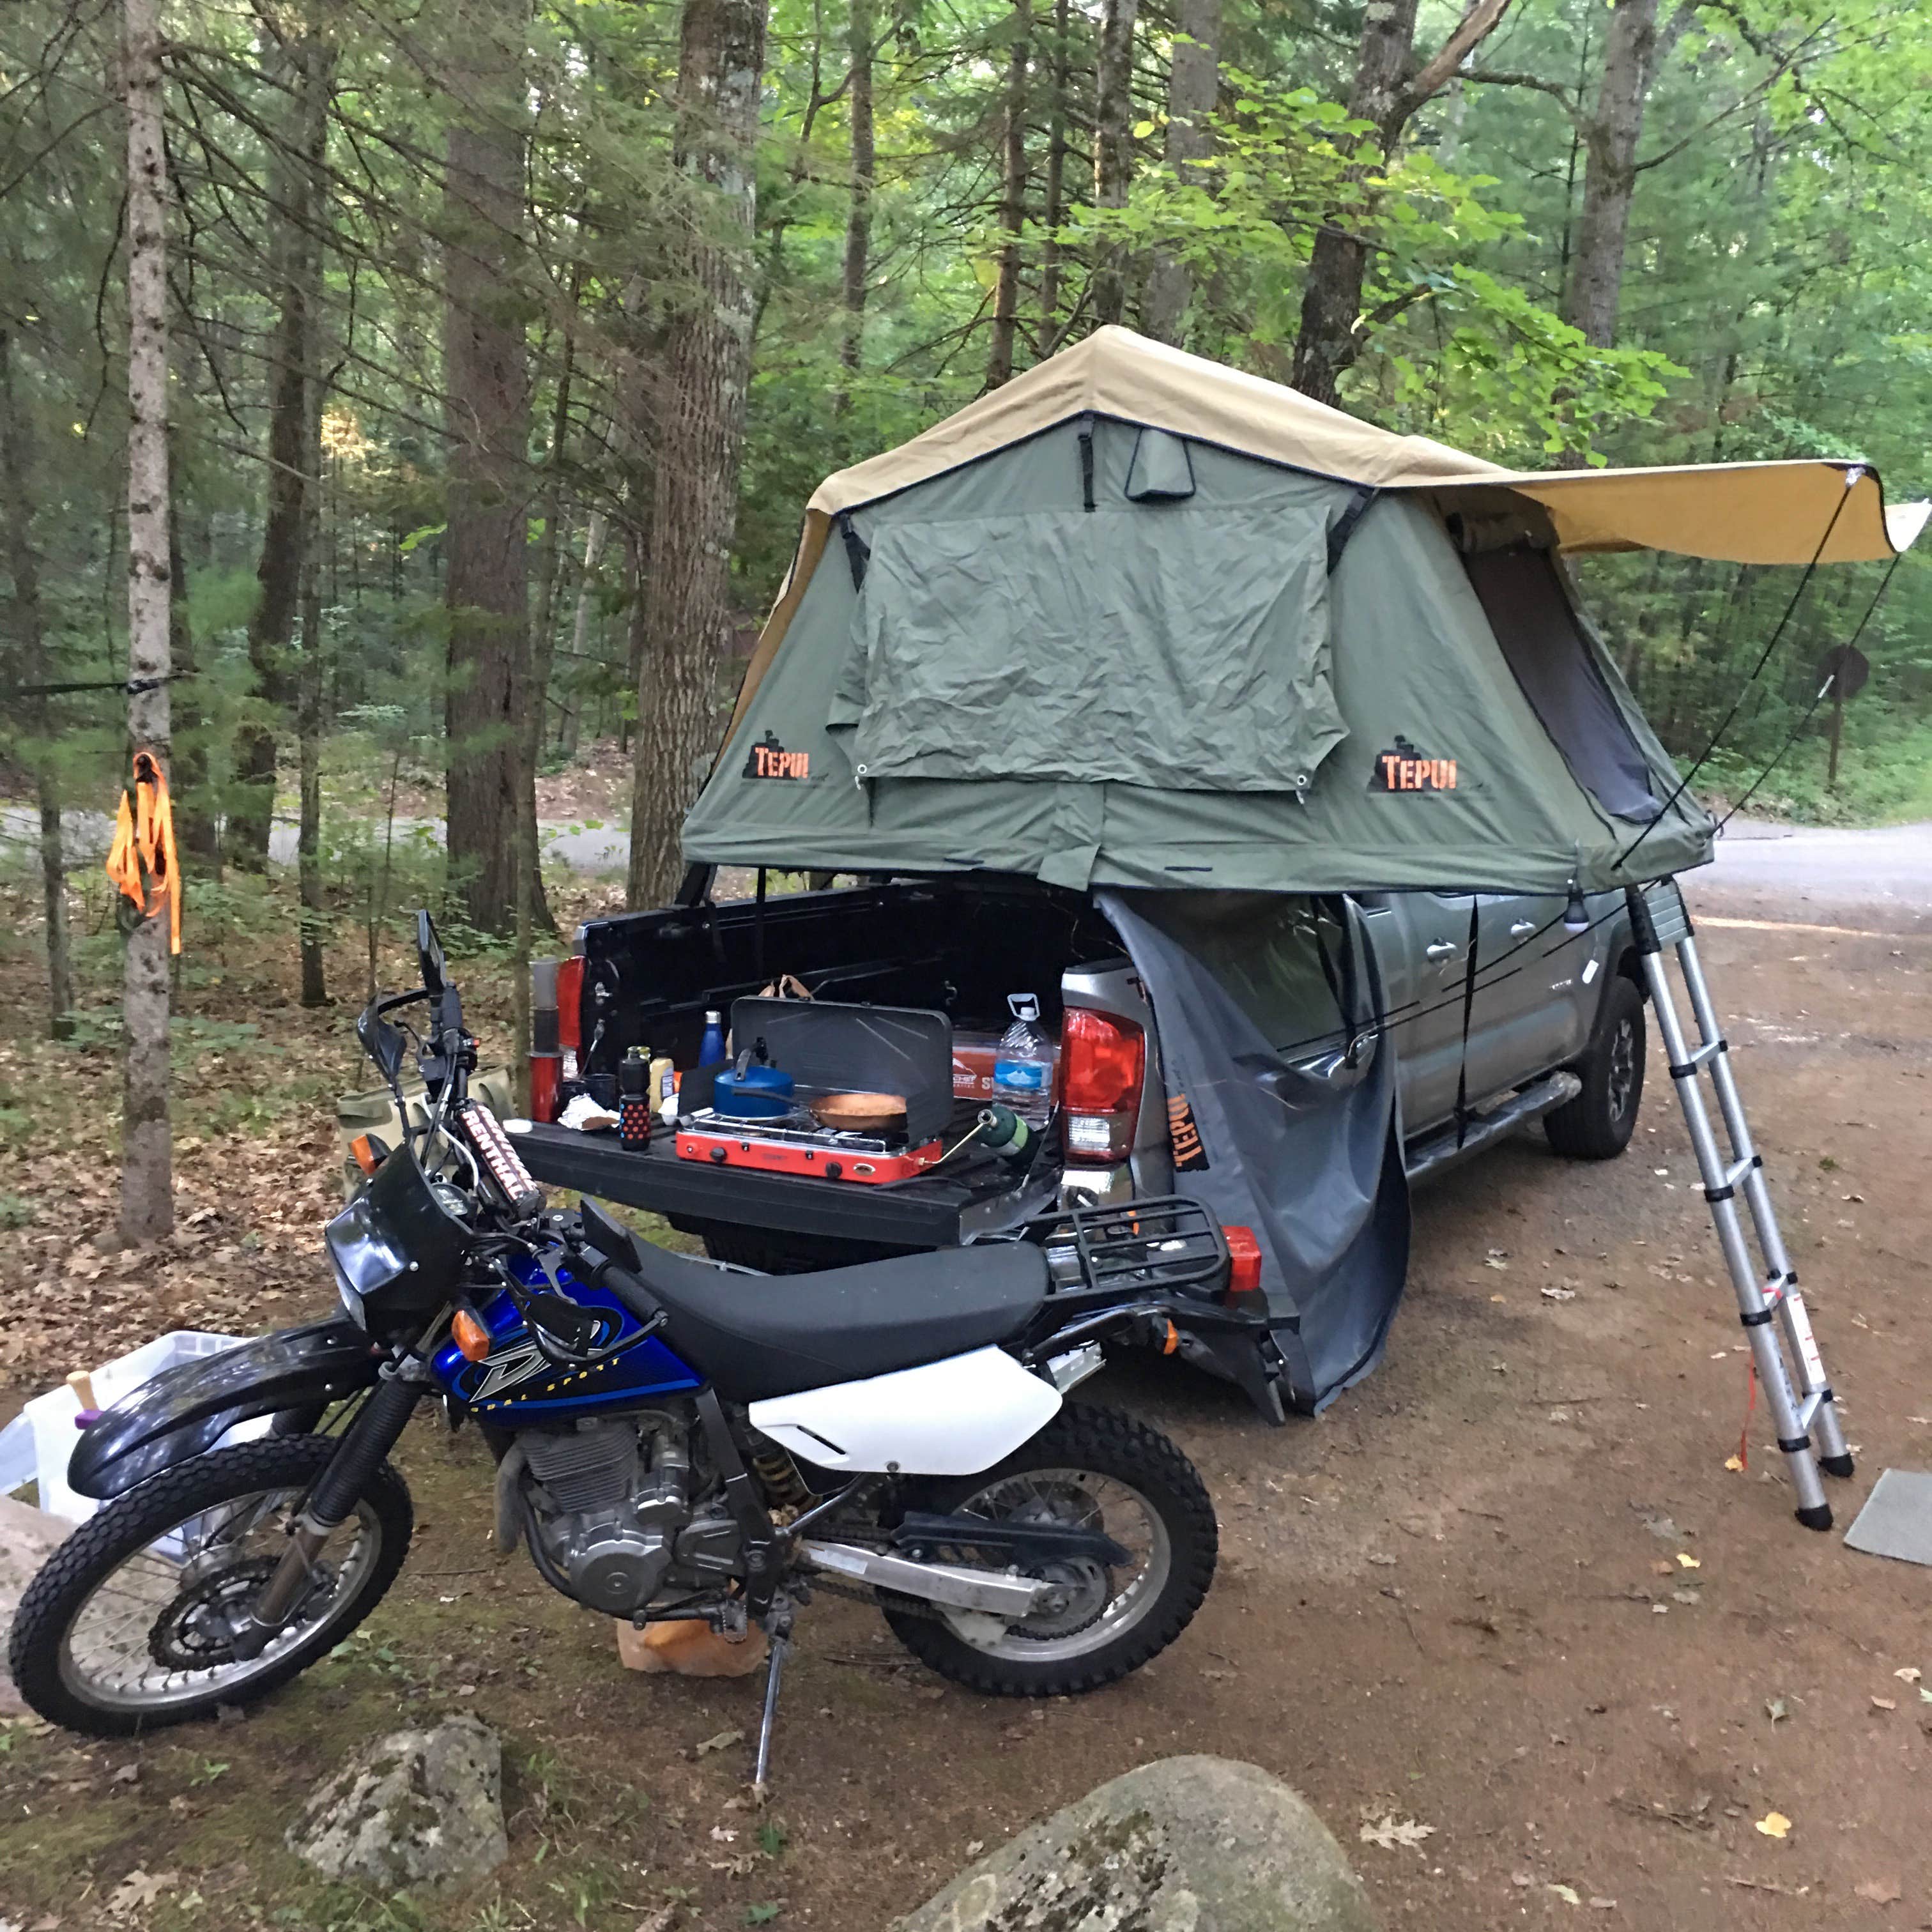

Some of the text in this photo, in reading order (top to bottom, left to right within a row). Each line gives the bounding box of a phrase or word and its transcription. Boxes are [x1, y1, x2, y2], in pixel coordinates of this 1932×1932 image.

[755, 747, 809, 778] TEPUI
[1381, 755, 1457, 790] TEPUI
[461, 1110, 524, 1200] RENTHAL
